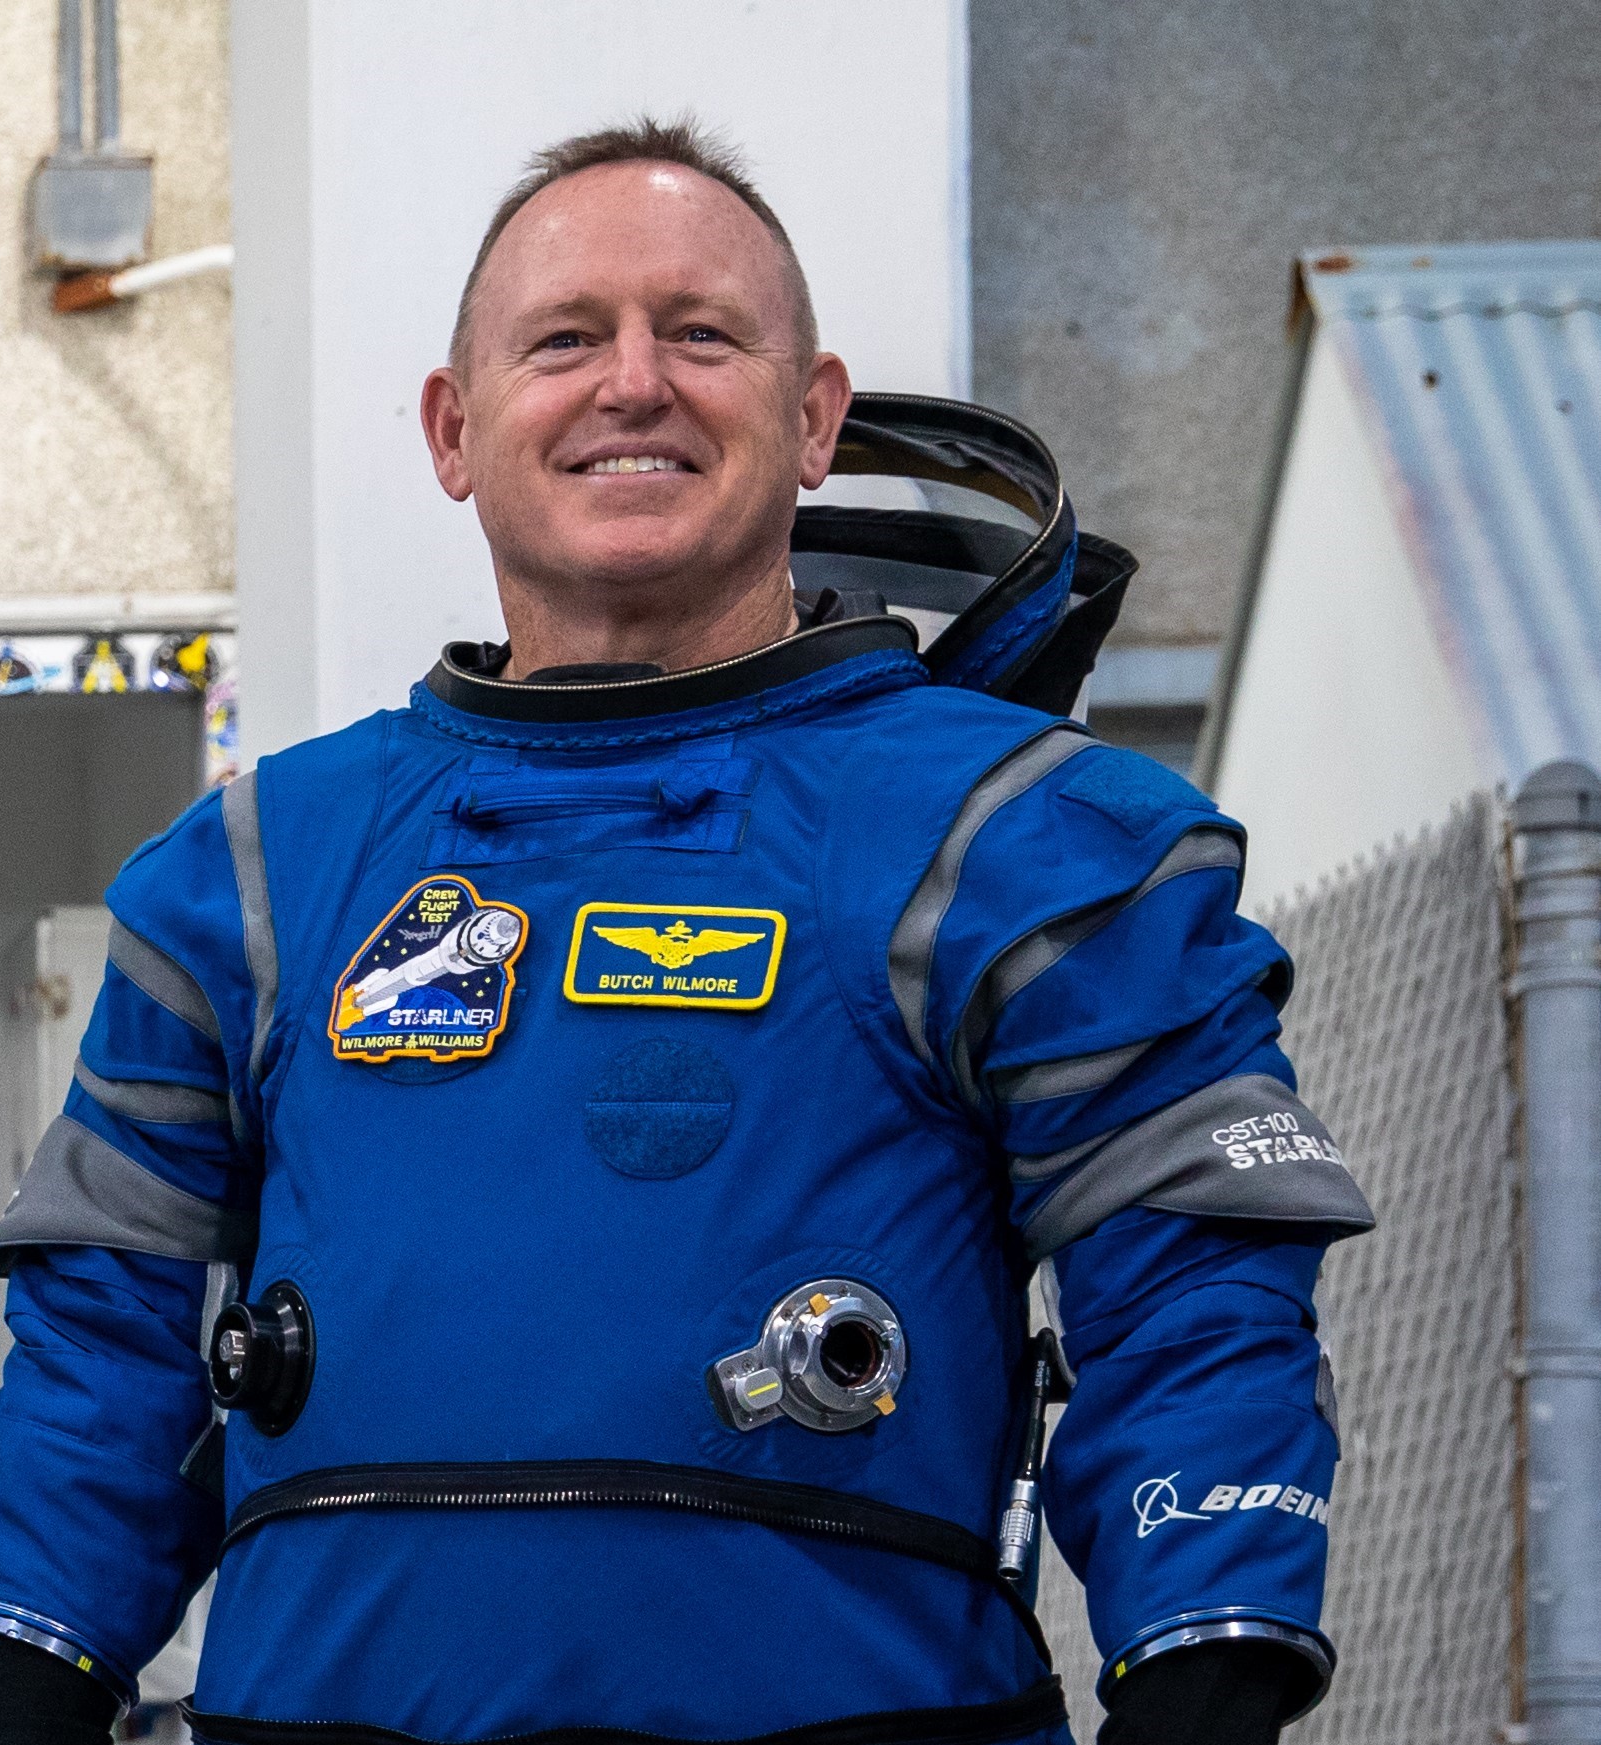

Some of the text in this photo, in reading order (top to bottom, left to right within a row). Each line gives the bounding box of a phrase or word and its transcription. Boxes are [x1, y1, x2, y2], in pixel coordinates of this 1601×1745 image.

[423, 888, 460, 900] CREW
[418, 900, 461, 912] FLIGHT
[419, 911, 452, 923] TEST
[598, 974, 738, 994] BUTCH WILMORE
[387, 1008, 494, 1026] STARLINER
[341, 1034, 485, 1050] WILMORE WILLIAMS
[1211, 1111, 1299, 1146] CST-100
[1198, 1483, 1331, 1526] BOEIN
